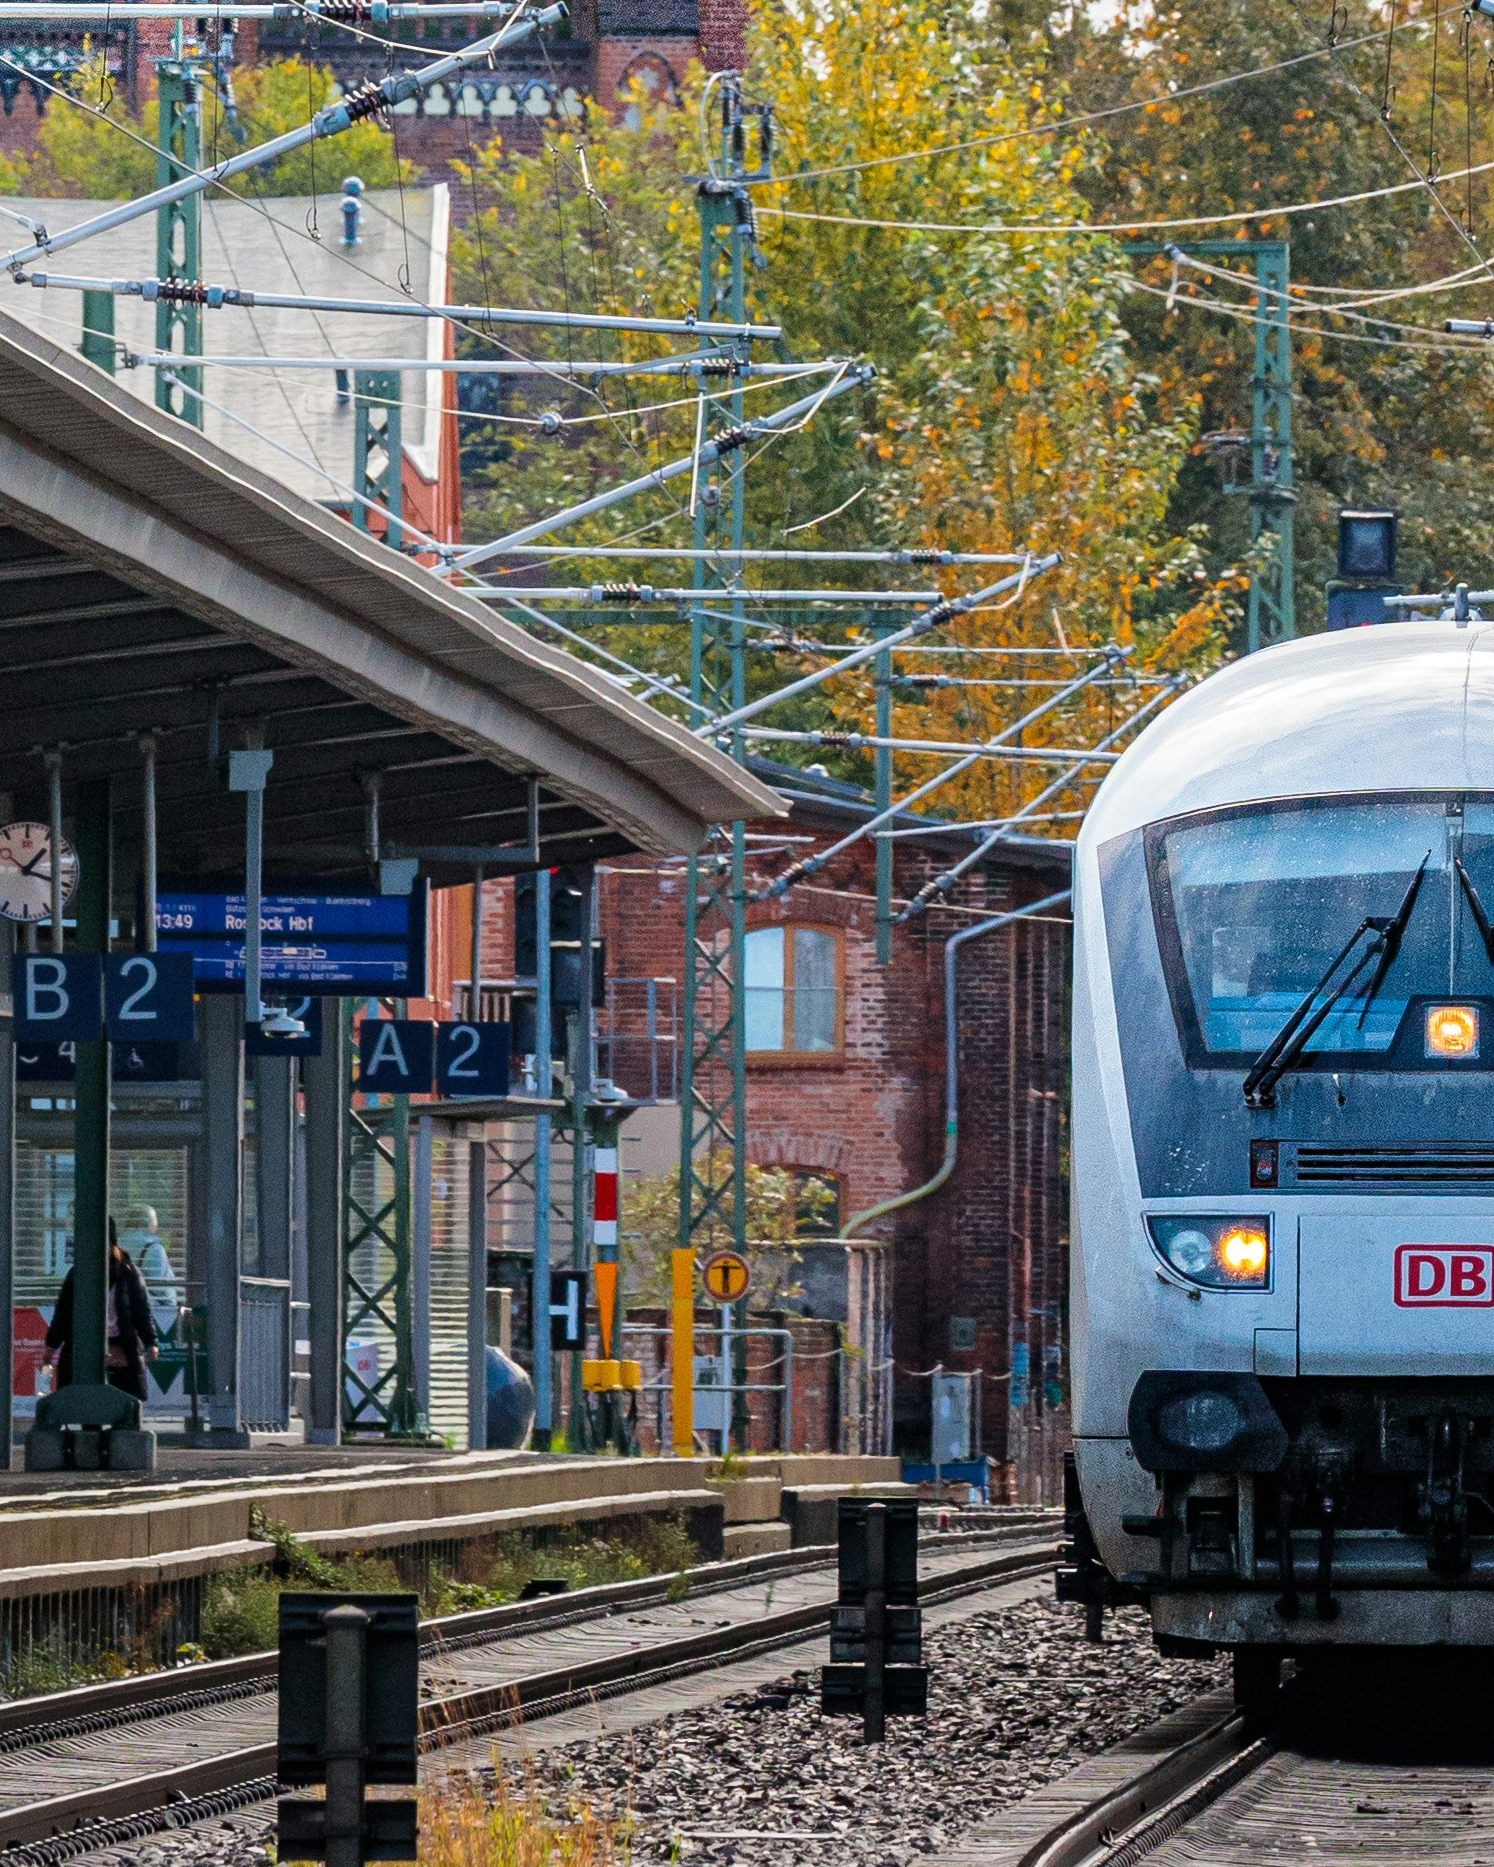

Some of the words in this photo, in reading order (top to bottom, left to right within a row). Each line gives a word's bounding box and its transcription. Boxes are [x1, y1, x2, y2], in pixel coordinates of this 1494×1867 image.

[157, 914, 193, 929] 13:49
[225, 914, 284, 931] Rosock
[26, 959, 69, 1021] B
[118, 957, 158, 1020] 2
[367, 1023, 409, 1077] A
[447, 1025, 481, 1078] 2
[1406, 1252, 1489, 1299] DB
